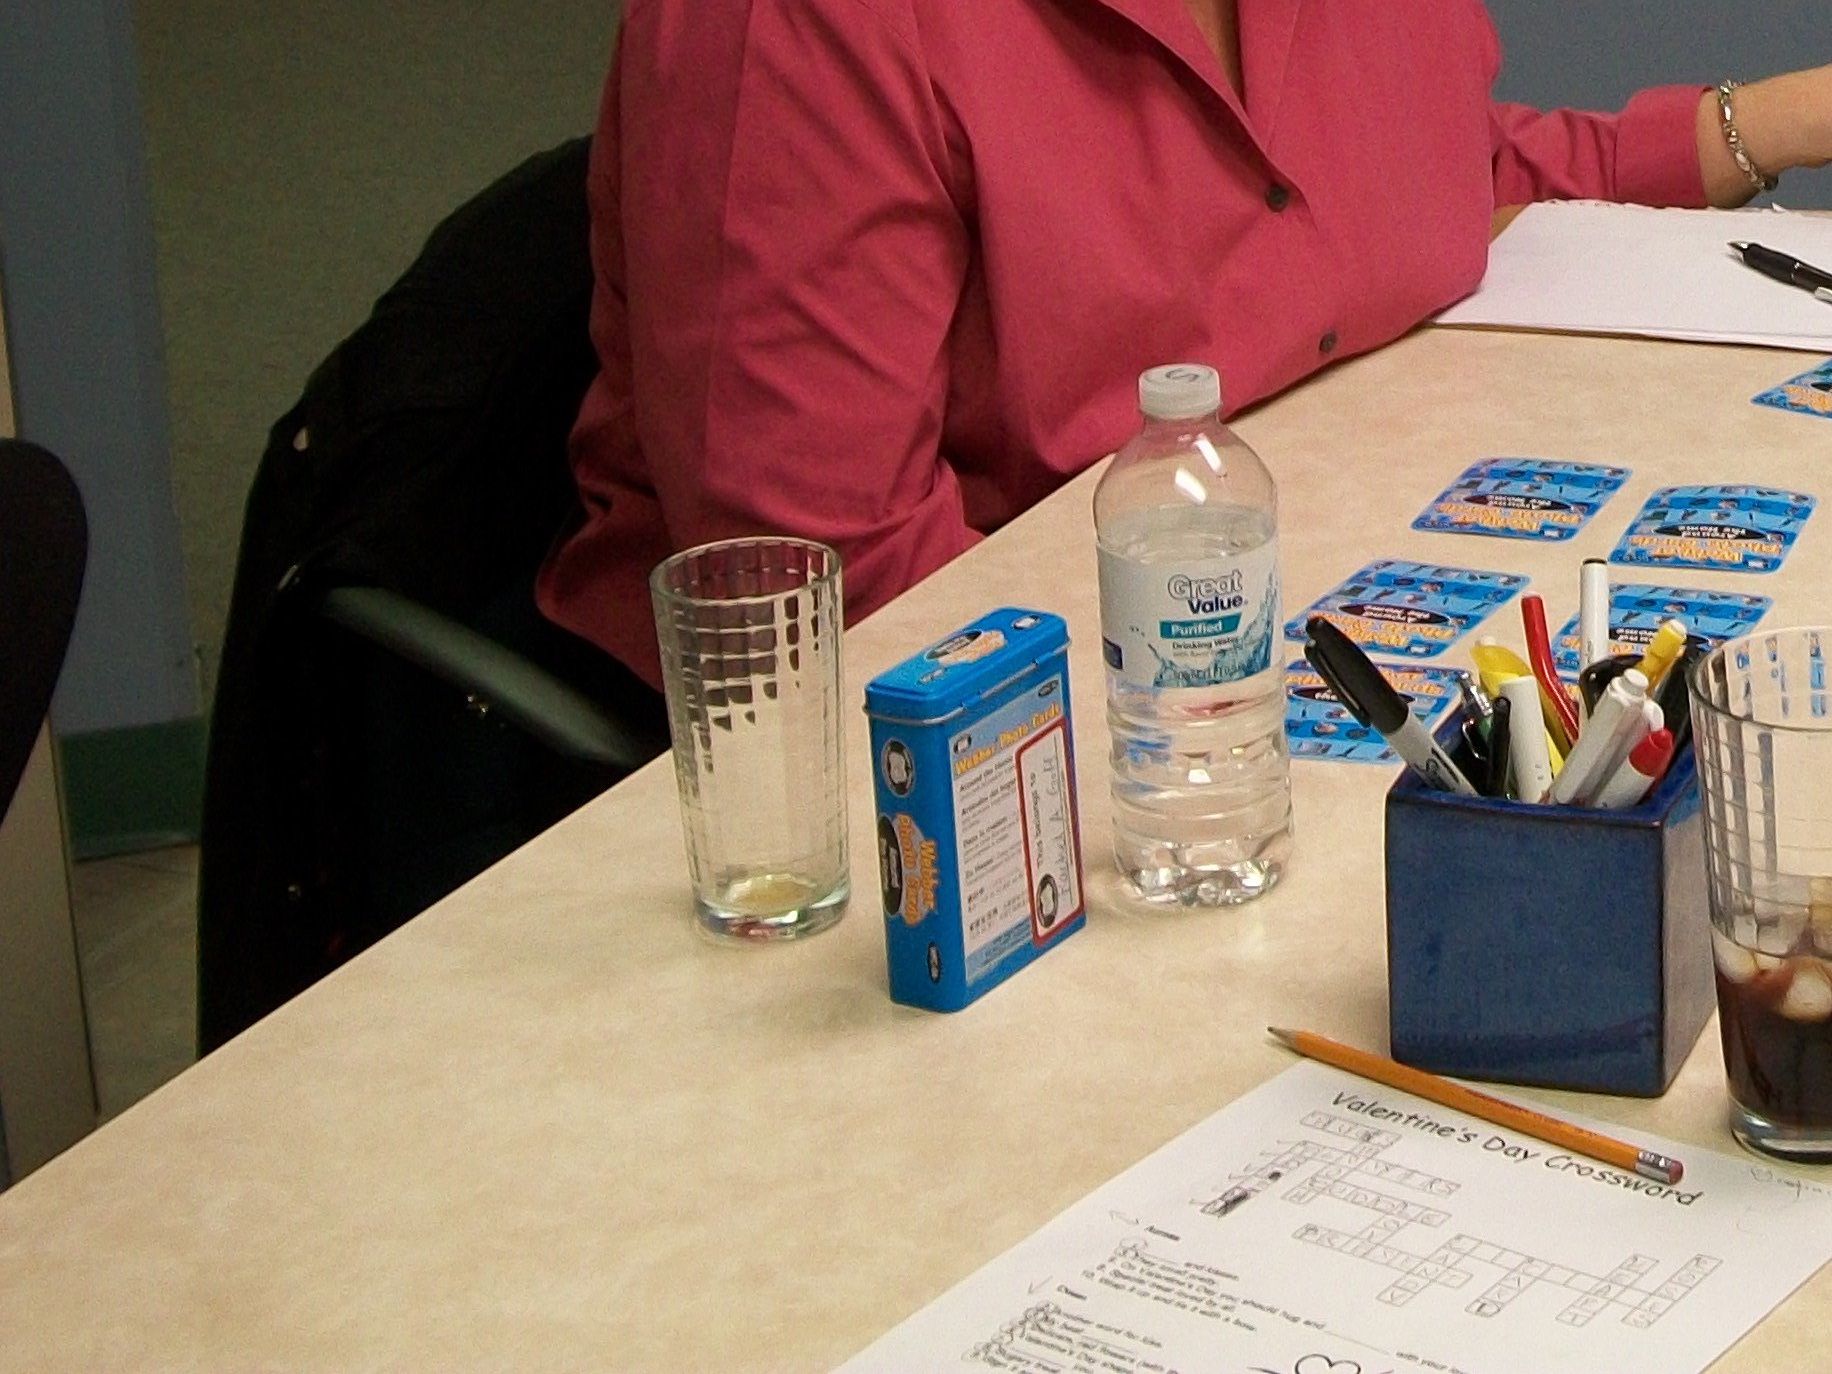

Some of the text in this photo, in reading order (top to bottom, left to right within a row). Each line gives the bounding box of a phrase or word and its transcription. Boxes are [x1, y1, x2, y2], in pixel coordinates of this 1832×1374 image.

[1167, 568, 1243, 601] Great
[1188, 595, 1243, 614] Value
[1171, 620, 1223, 636] Purified
[1332, 1091, 1480, 1144] Valentine's
[1483, 1134, 1541, 1162] Day
[1544, 1153, 1704, 1207] Crossword
